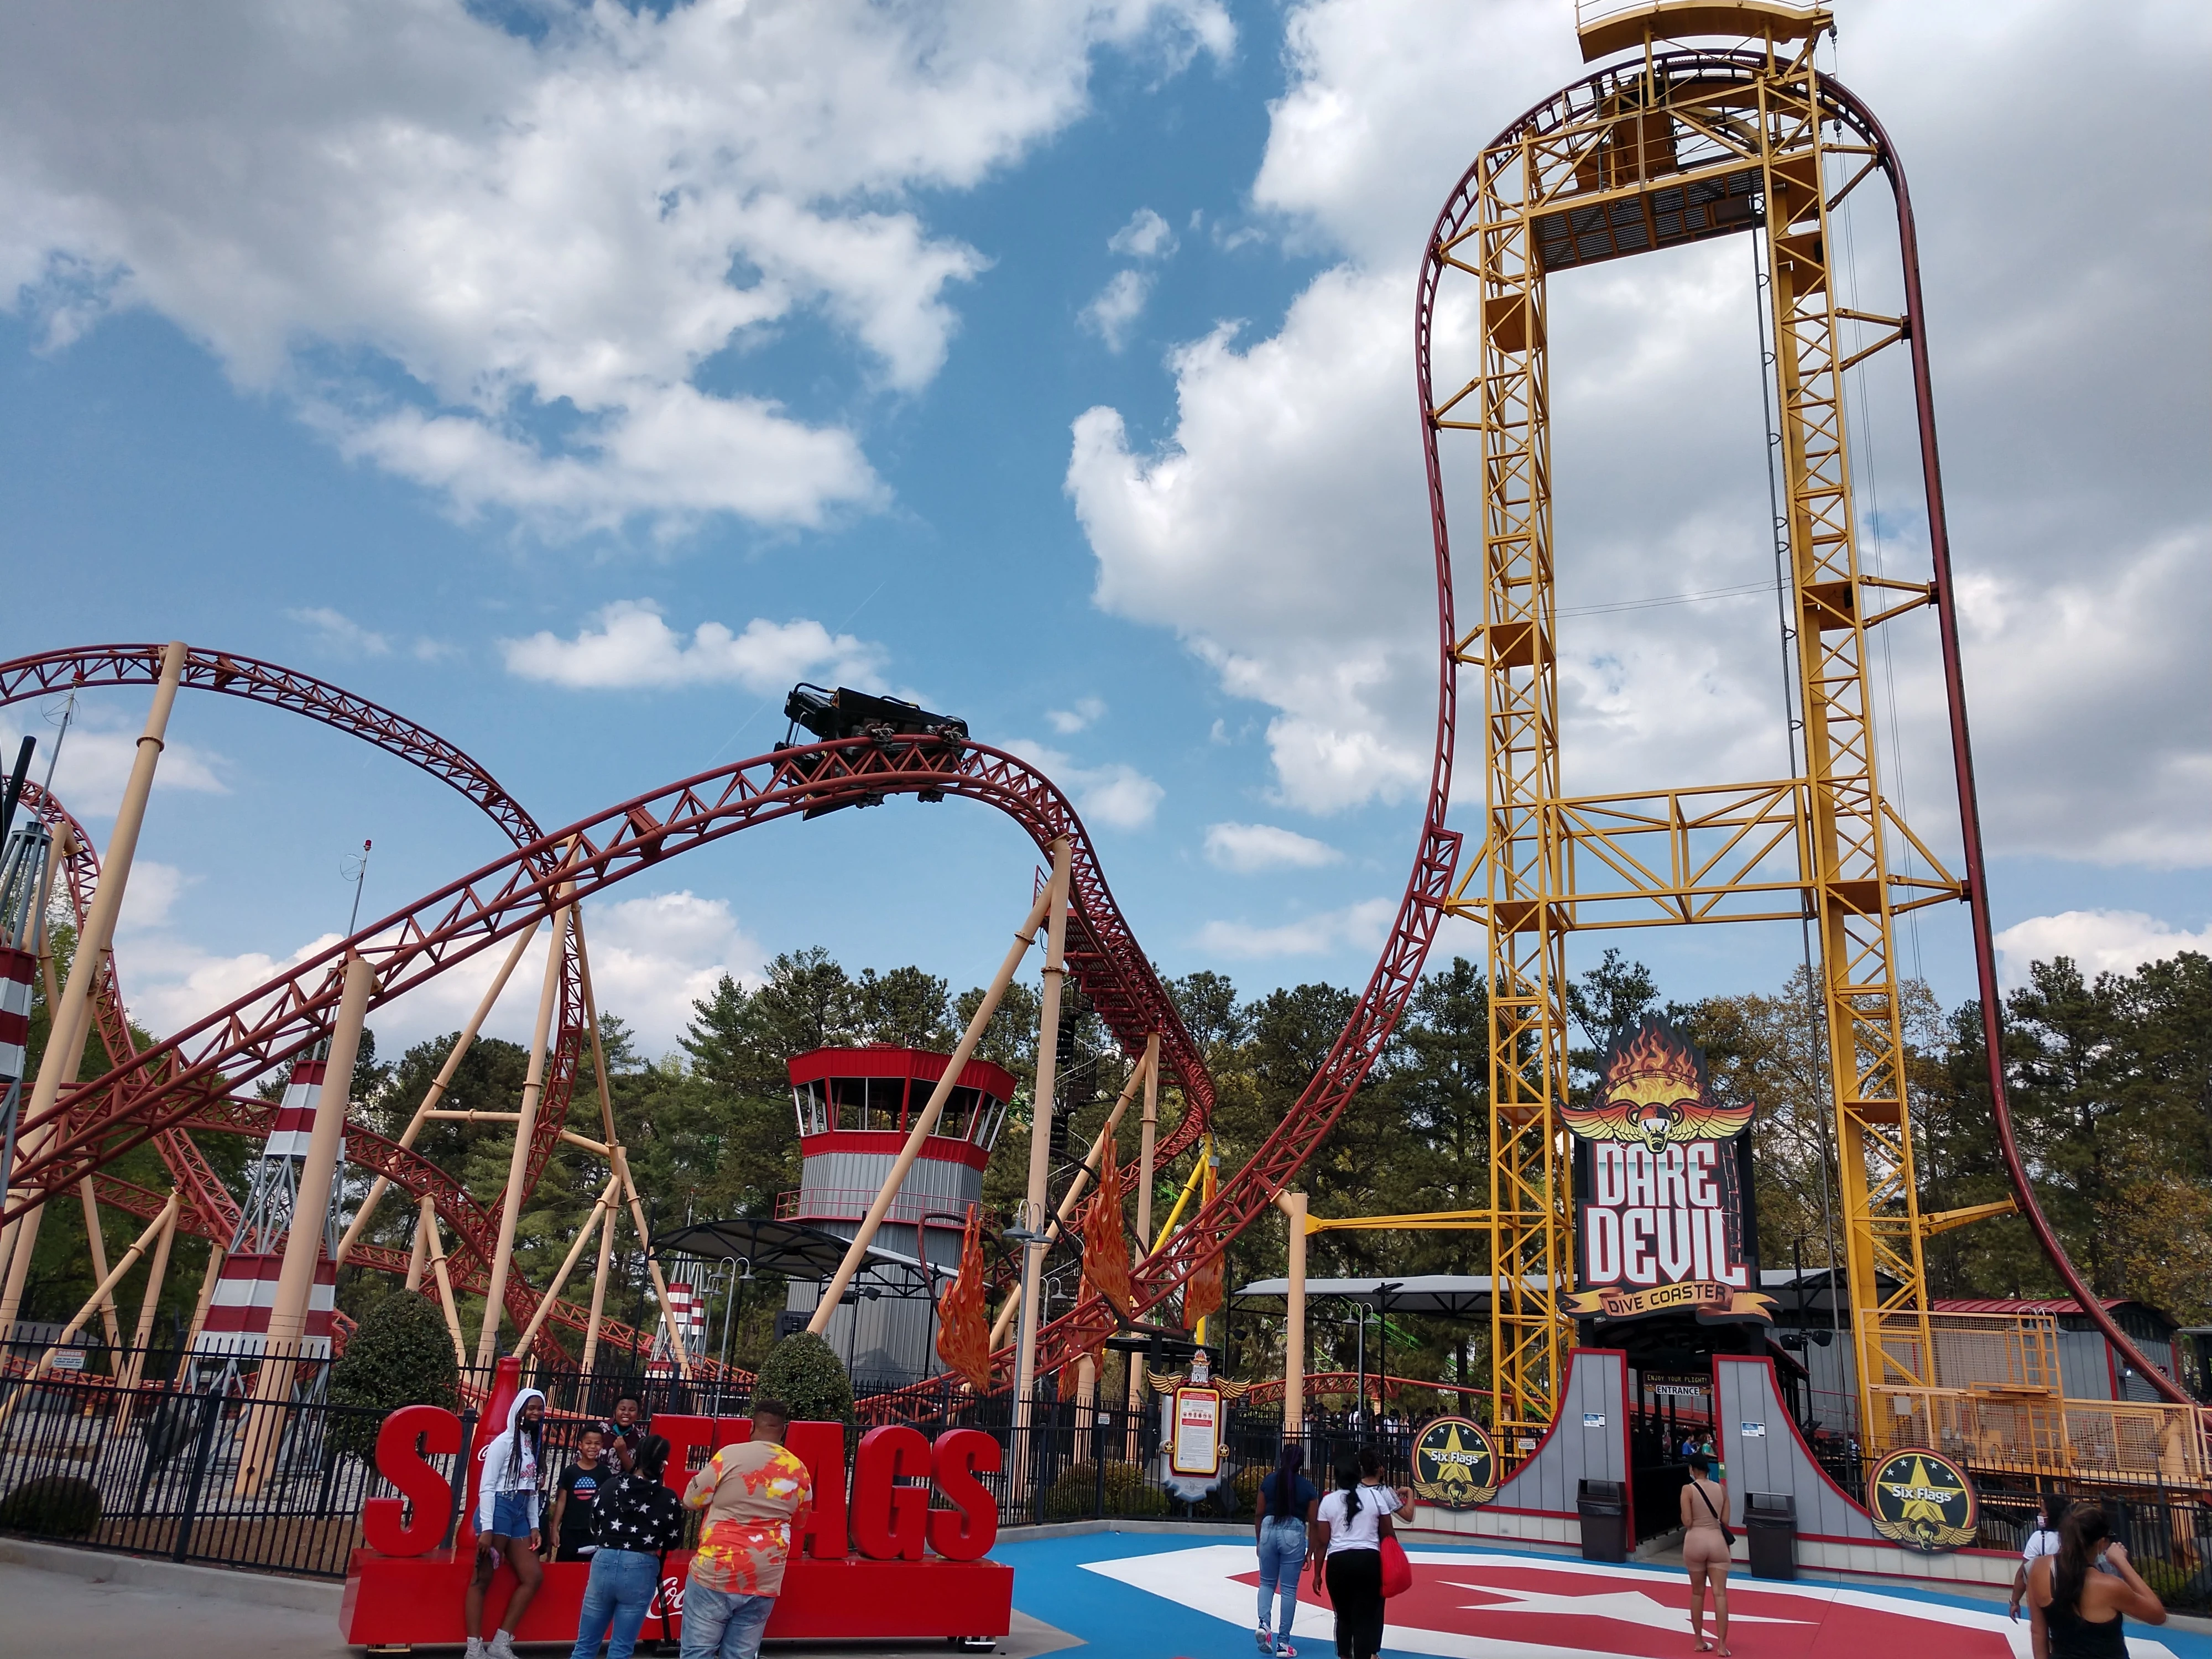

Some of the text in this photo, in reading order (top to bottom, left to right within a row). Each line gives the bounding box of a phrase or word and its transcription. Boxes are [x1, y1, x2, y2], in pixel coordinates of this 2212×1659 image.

[1597, 1142, 1718, 1209] DARE
[1587, 1207, 1746, 1286] DEVIL
[1608, 1284, 1726, 1313] DIVE COASTER
[1192, 1373, 1208, 1383] DEVIL
[1657, 1386, 1699, 1395] ENTRANCE
[1431, 1451, 1479, 1465] Six Flags
[1892, 1485, 1952, 1503] Six Flags
